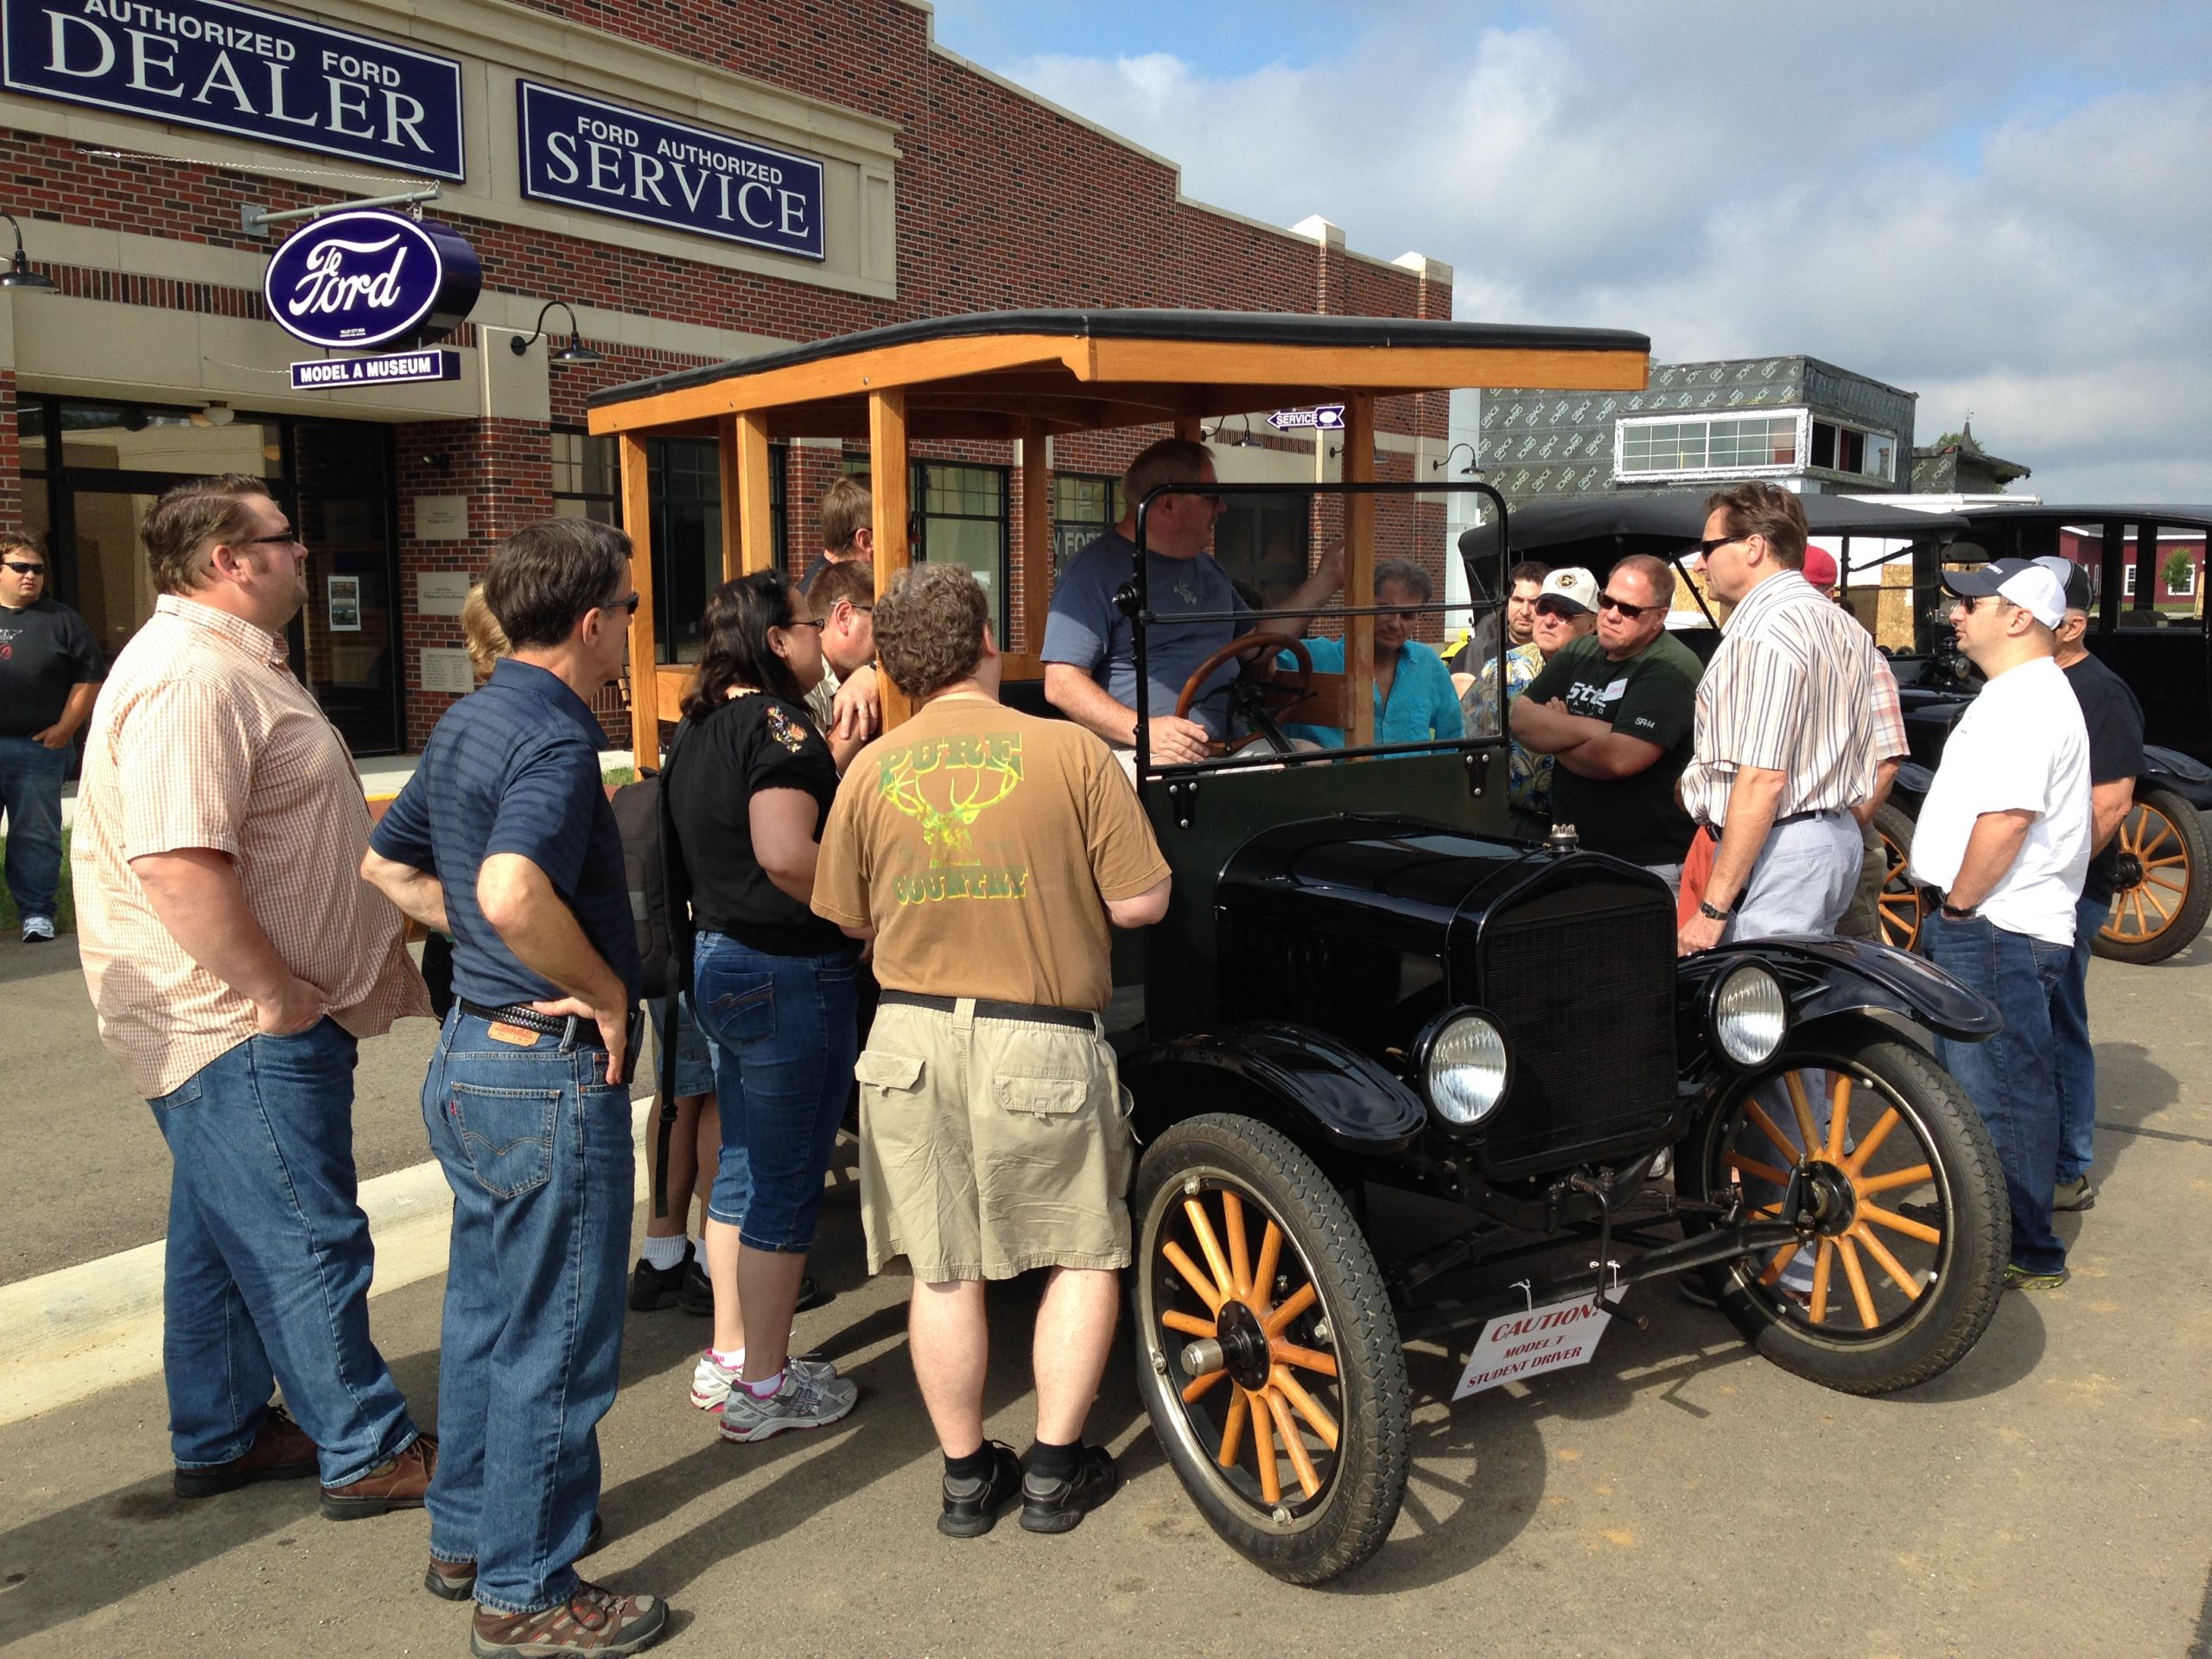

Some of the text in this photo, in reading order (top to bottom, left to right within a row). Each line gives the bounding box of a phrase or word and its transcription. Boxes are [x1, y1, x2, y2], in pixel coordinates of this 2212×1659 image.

[84, 0, 401, 87] AUTHORIZED FORD
[42, 8, 435, 153] DEALER
[577, 116, 783, 185] FORD AUTHORIZED
[546, 130, 809, 238] SERVICE
[288, 232, 408, 316] Ford
[300, 357, 431, 383] MODEL A MUSEUM
[1571, 399, 1592, 422] GRACE
[1700, 390, 1719, 408] RACE
[1276, 414, 1318, 424] SERVICE
[1480, 405, 1501, 427] GRACE
[1525, 402, 1546, 425] GRACE
[1494, 437, 1514, 460] GRACE
[1539, 435, 1559, 457] GRACE
[1585, 432, 1606, 454] GRACE
[1635, 717, 1655, 728] SR-14
[877, 733, 1024, 795] PURE
[1503, 1335, 1567, 1360] MODEL T
[1467, 1346, 1583, 1388] STUDENT DRIVER
